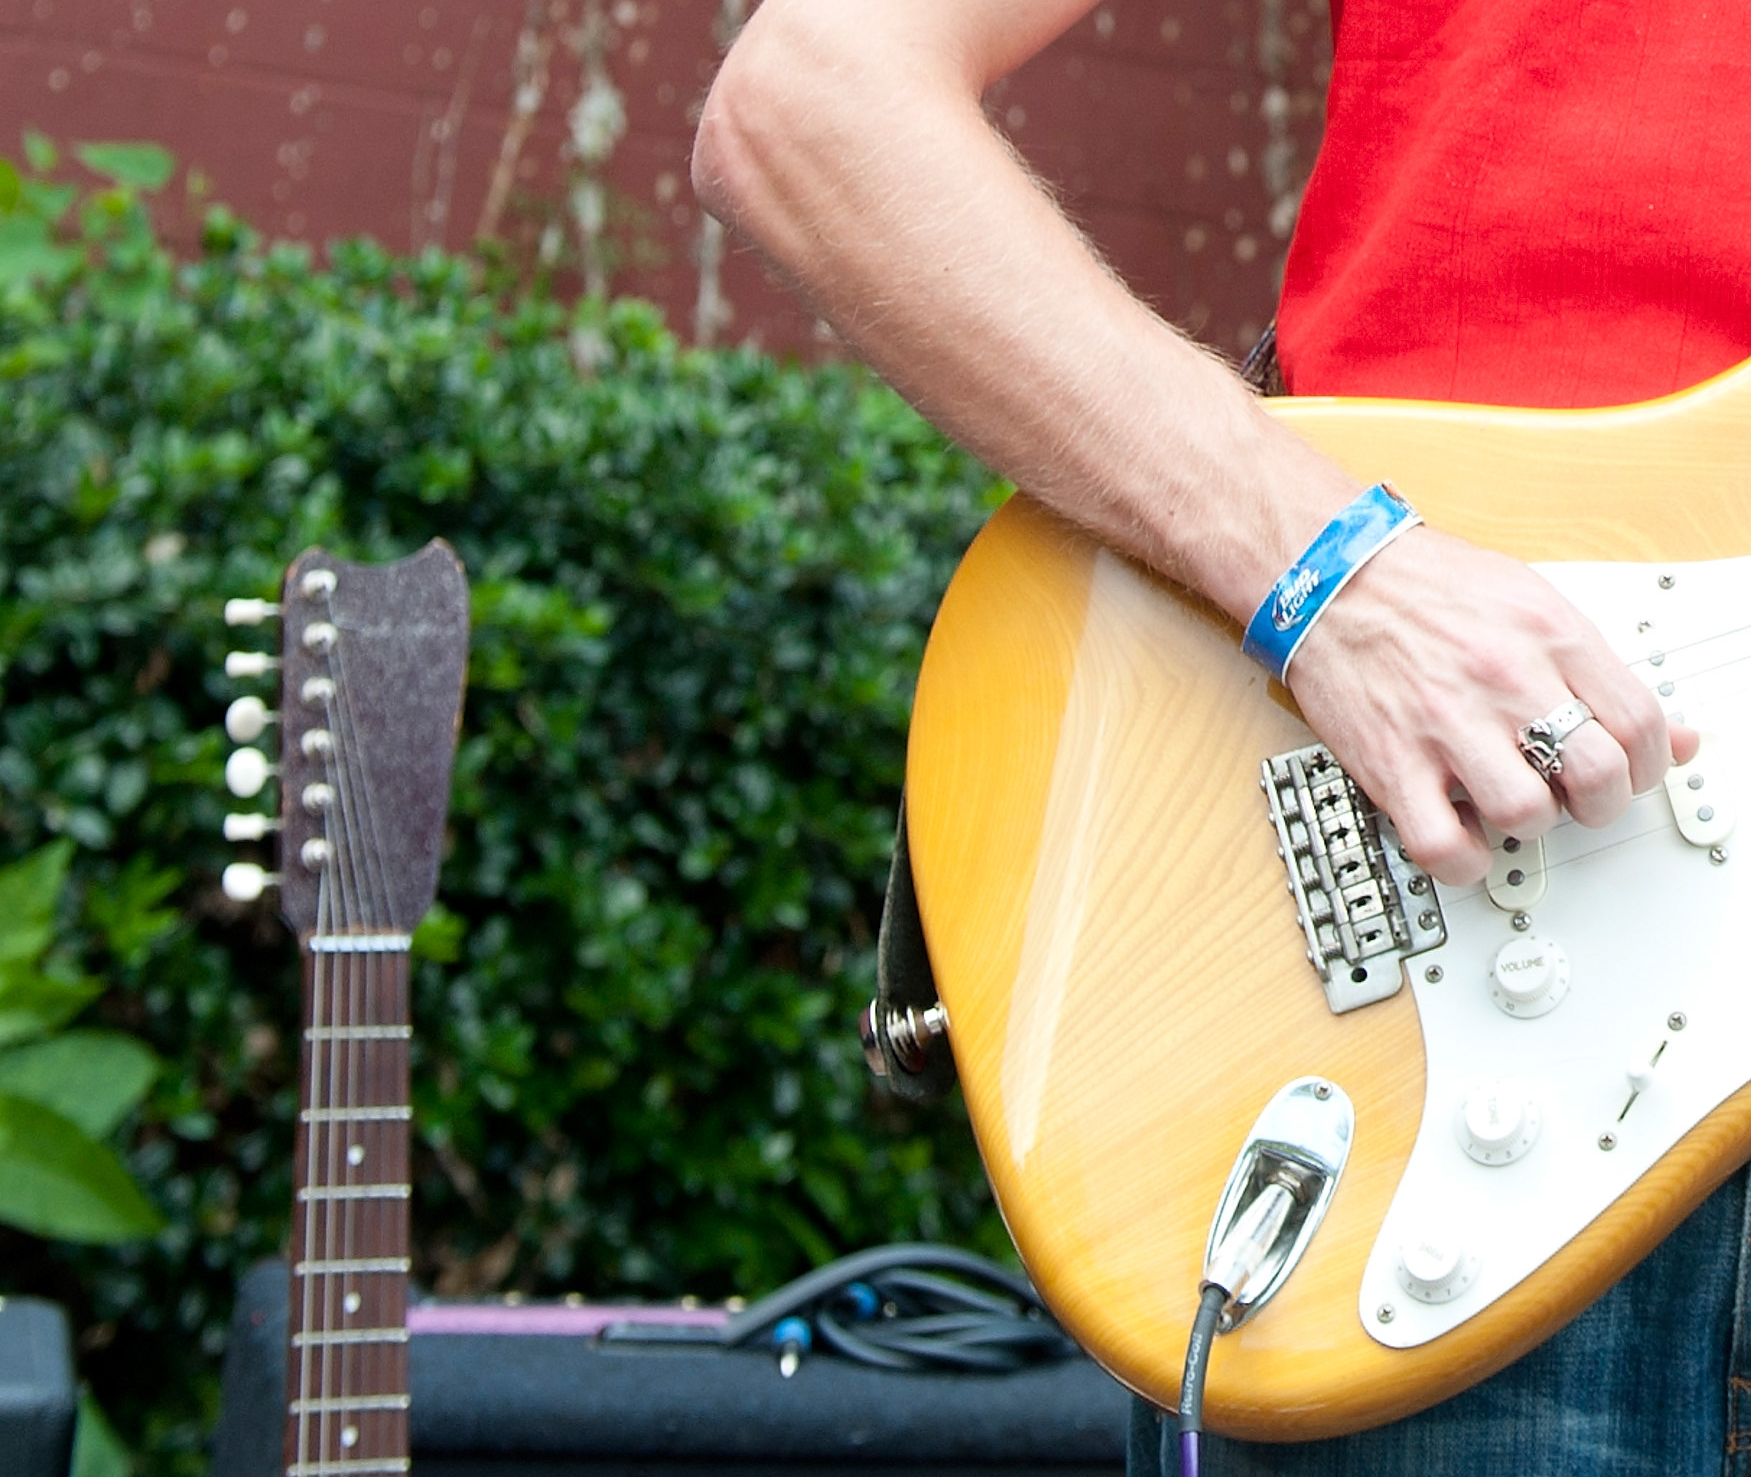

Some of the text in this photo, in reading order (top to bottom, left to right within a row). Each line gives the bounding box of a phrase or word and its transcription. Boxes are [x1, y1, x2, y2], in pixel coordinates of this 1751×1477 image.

[1279, 568, 1311, 609] BUD
[1282, 569, 1320, 624] LIGHT
[1501, 956, 1544, 972] VOLUME
